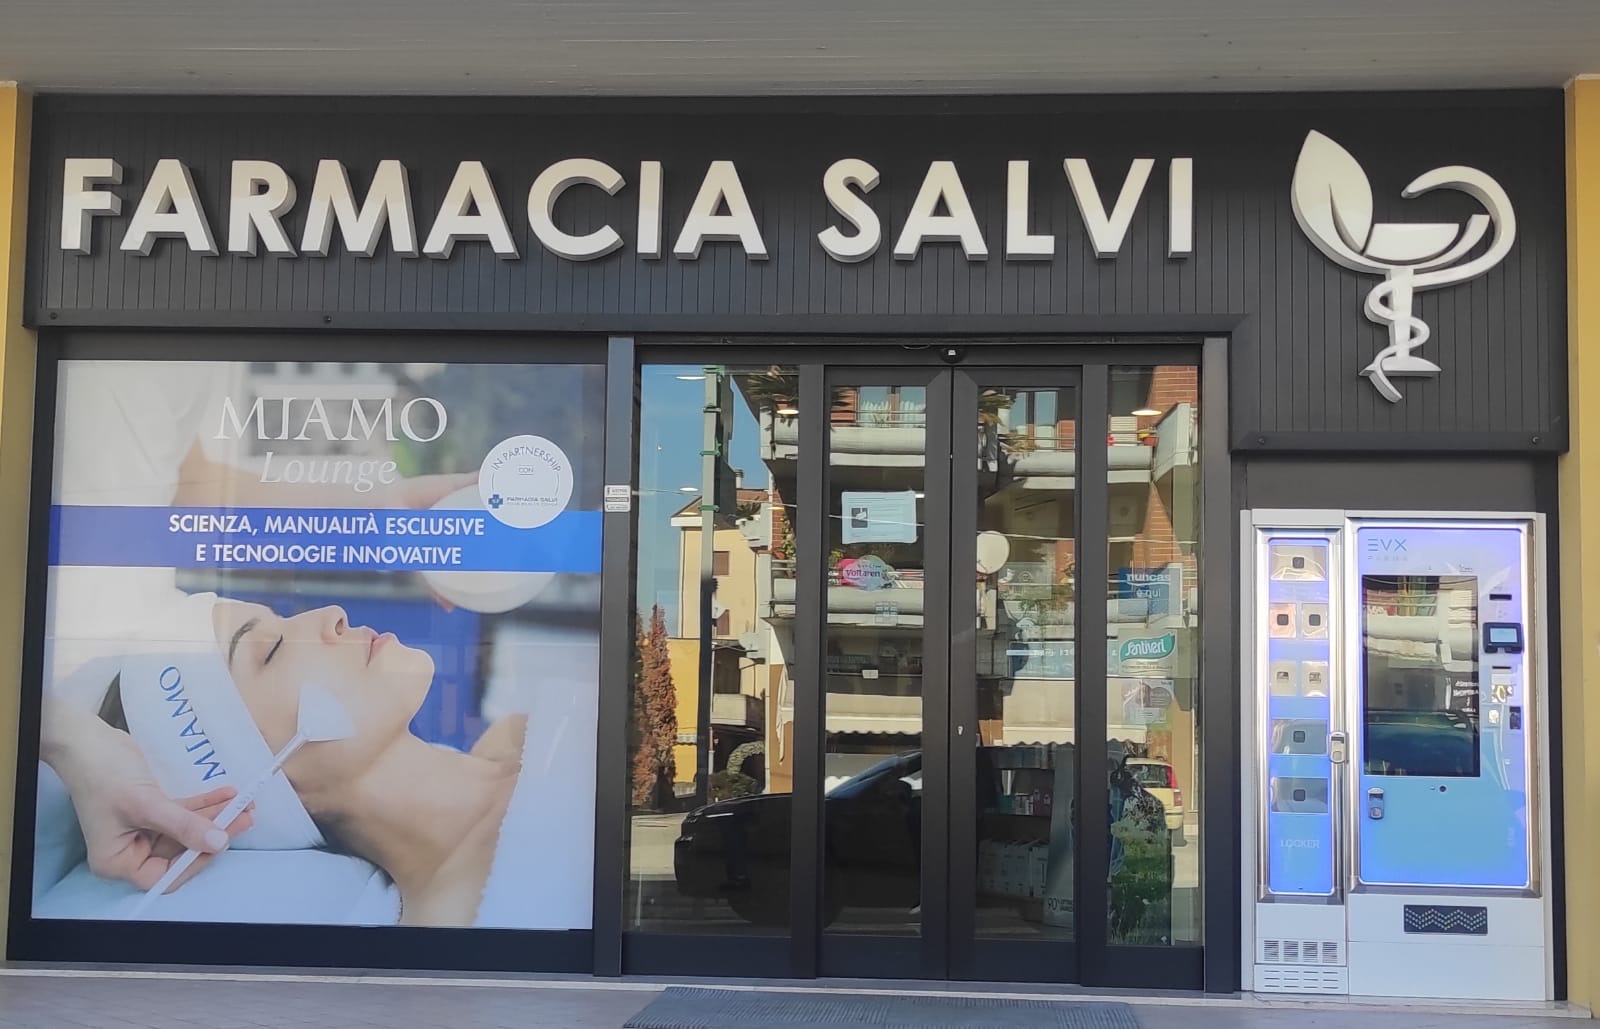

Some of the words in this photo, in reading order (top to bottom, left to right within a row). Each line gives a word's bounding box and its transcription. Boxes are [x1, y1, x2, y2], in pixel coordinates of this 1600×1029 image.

[60, 157, 769, 262] FARMACIA
[817, 157, 1194, 263] SALVI
[213, 396, 448, 443] MIAMO
[492, 458, 504, 470] IN
[503, 446, 561, 472] PARTNERSHIP
[259, 451, 398, 493] Lounge
[168, 514, 258, 536] SCIENZA,
[264, 512, 380, 536] MANUALITÀ
[385, 517, 485, 537] ESCLUSIVE
[195, 543, 207, 562] E
[212, 544, 337, 564] TECNOLOGIE
[342, 545, 462, 566] INNOVATIVE
[1367, 538, 1408, 552] EVX
[845, 569, 881, 578] Voltaren
[1126, 574, 1170, 582] nuncas
[159, 665, 227, 782] MIAMO
